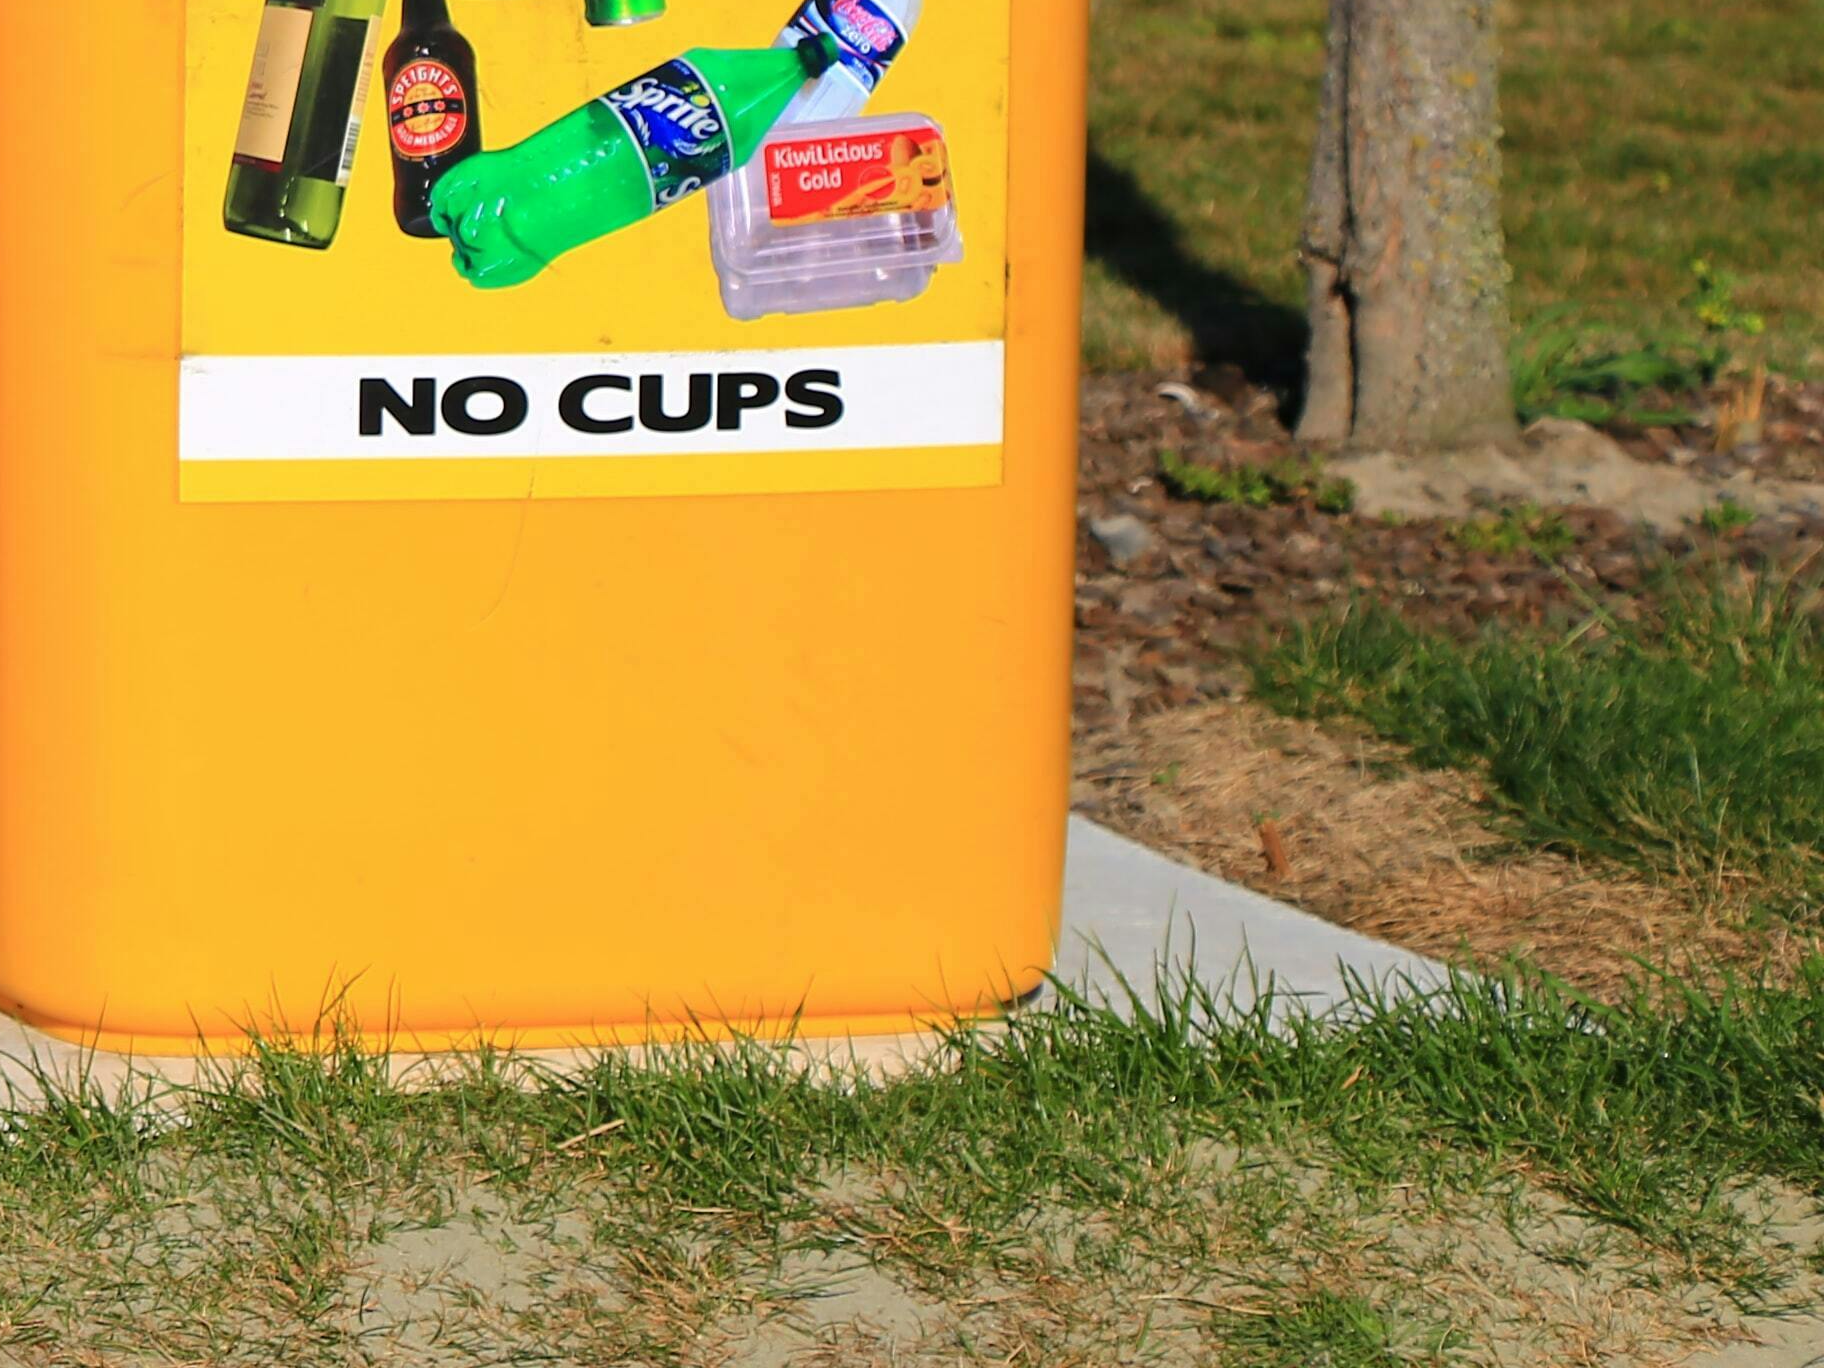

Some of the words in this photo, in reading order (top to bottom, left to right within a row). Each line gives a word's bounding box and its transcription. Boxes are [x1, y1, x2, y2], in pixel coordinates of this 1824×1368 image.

[608, 77, 721, 140] Sprite
[773, 139, 883, 169] KiwiLicious
[799, 168, 843, 192] Gold
[359, 377, 528, 435] NO
[557, 368, 843, 432] CUPS
